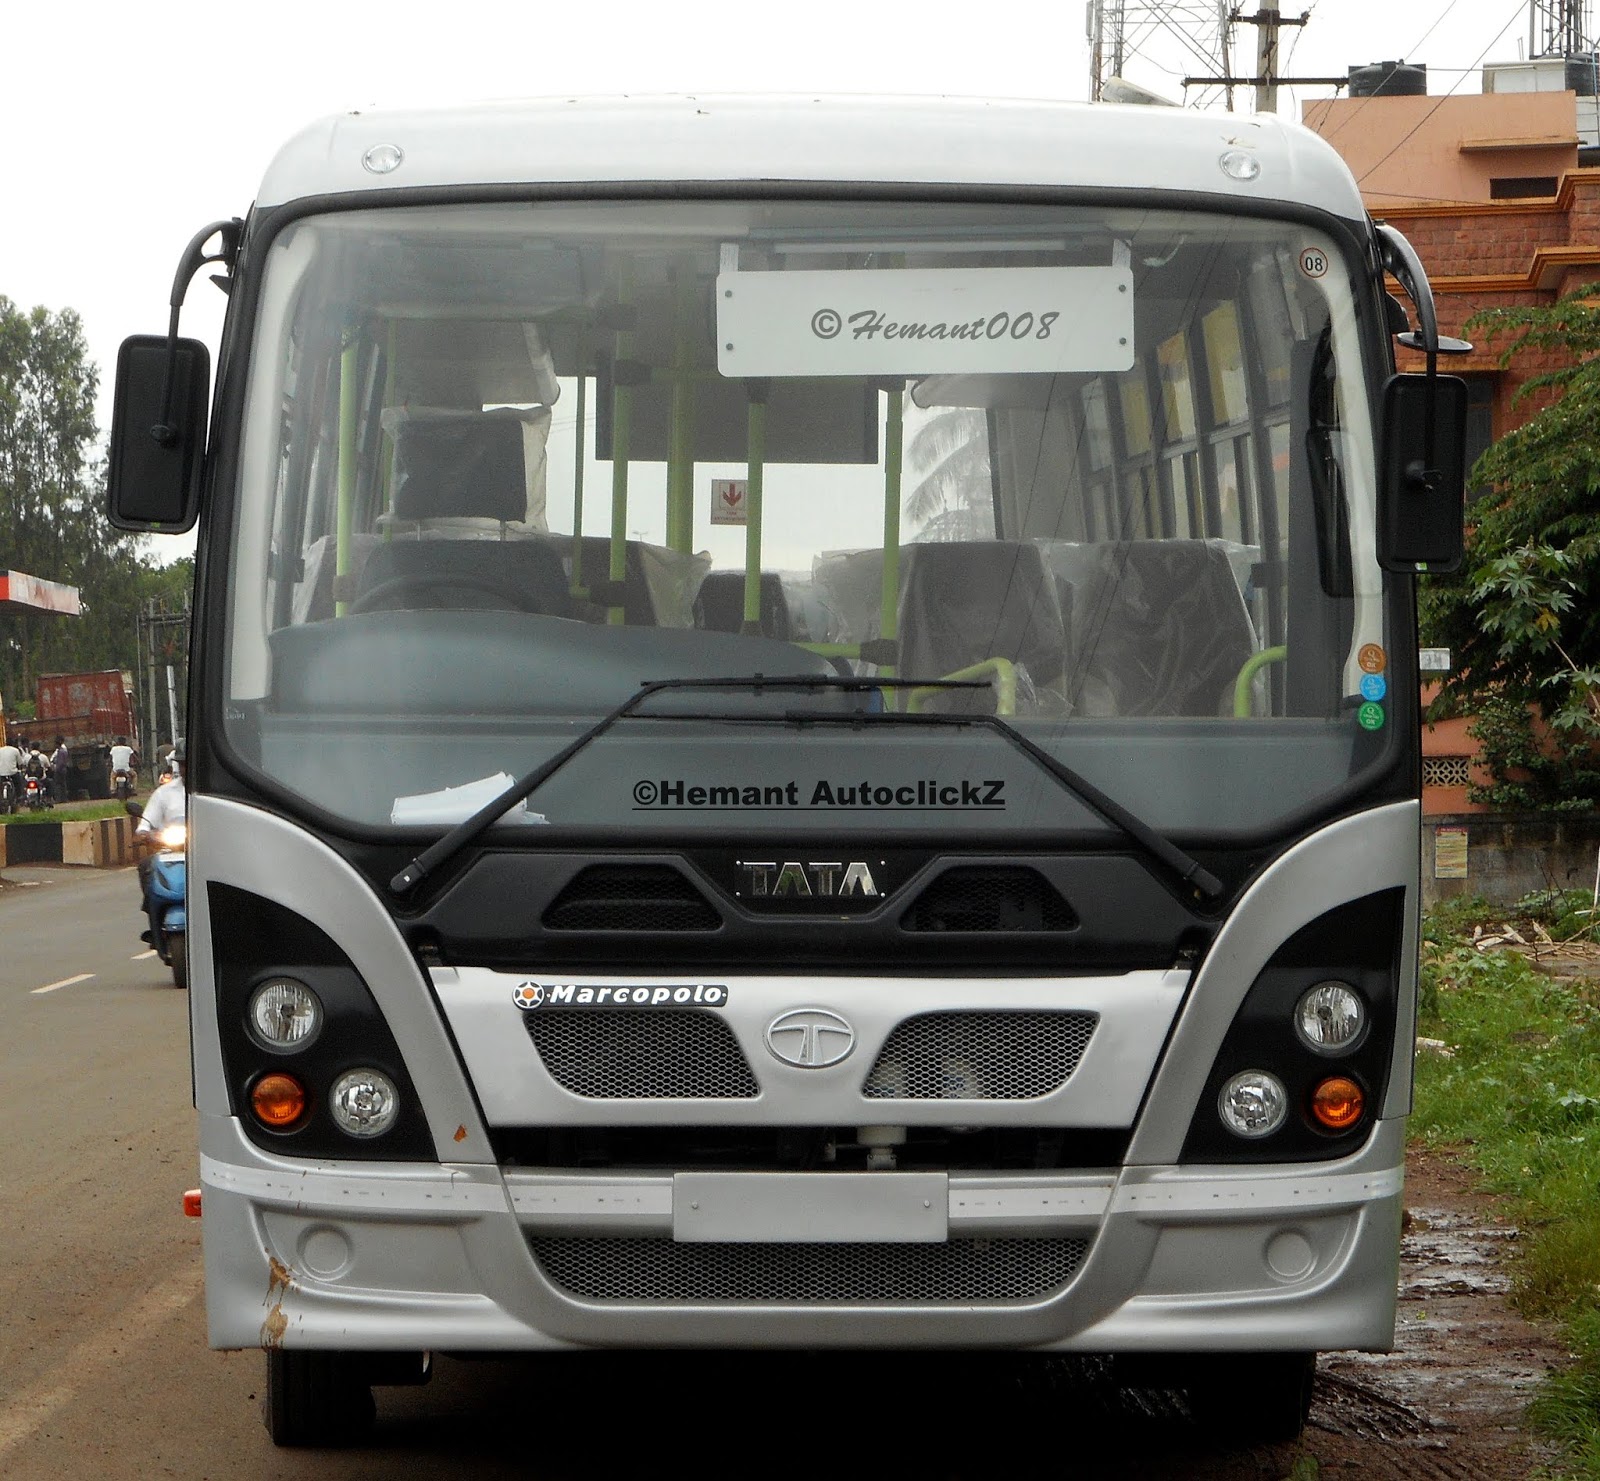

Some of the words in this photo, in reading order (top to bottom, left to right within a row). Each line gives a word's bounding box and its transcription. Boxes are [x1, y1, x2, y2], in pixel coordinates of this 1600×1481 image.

[1305, 256, 1323, 272] 08
[743, 861, 878, 896] TATA
[549, 985, 723, 1005] Marcopolo
